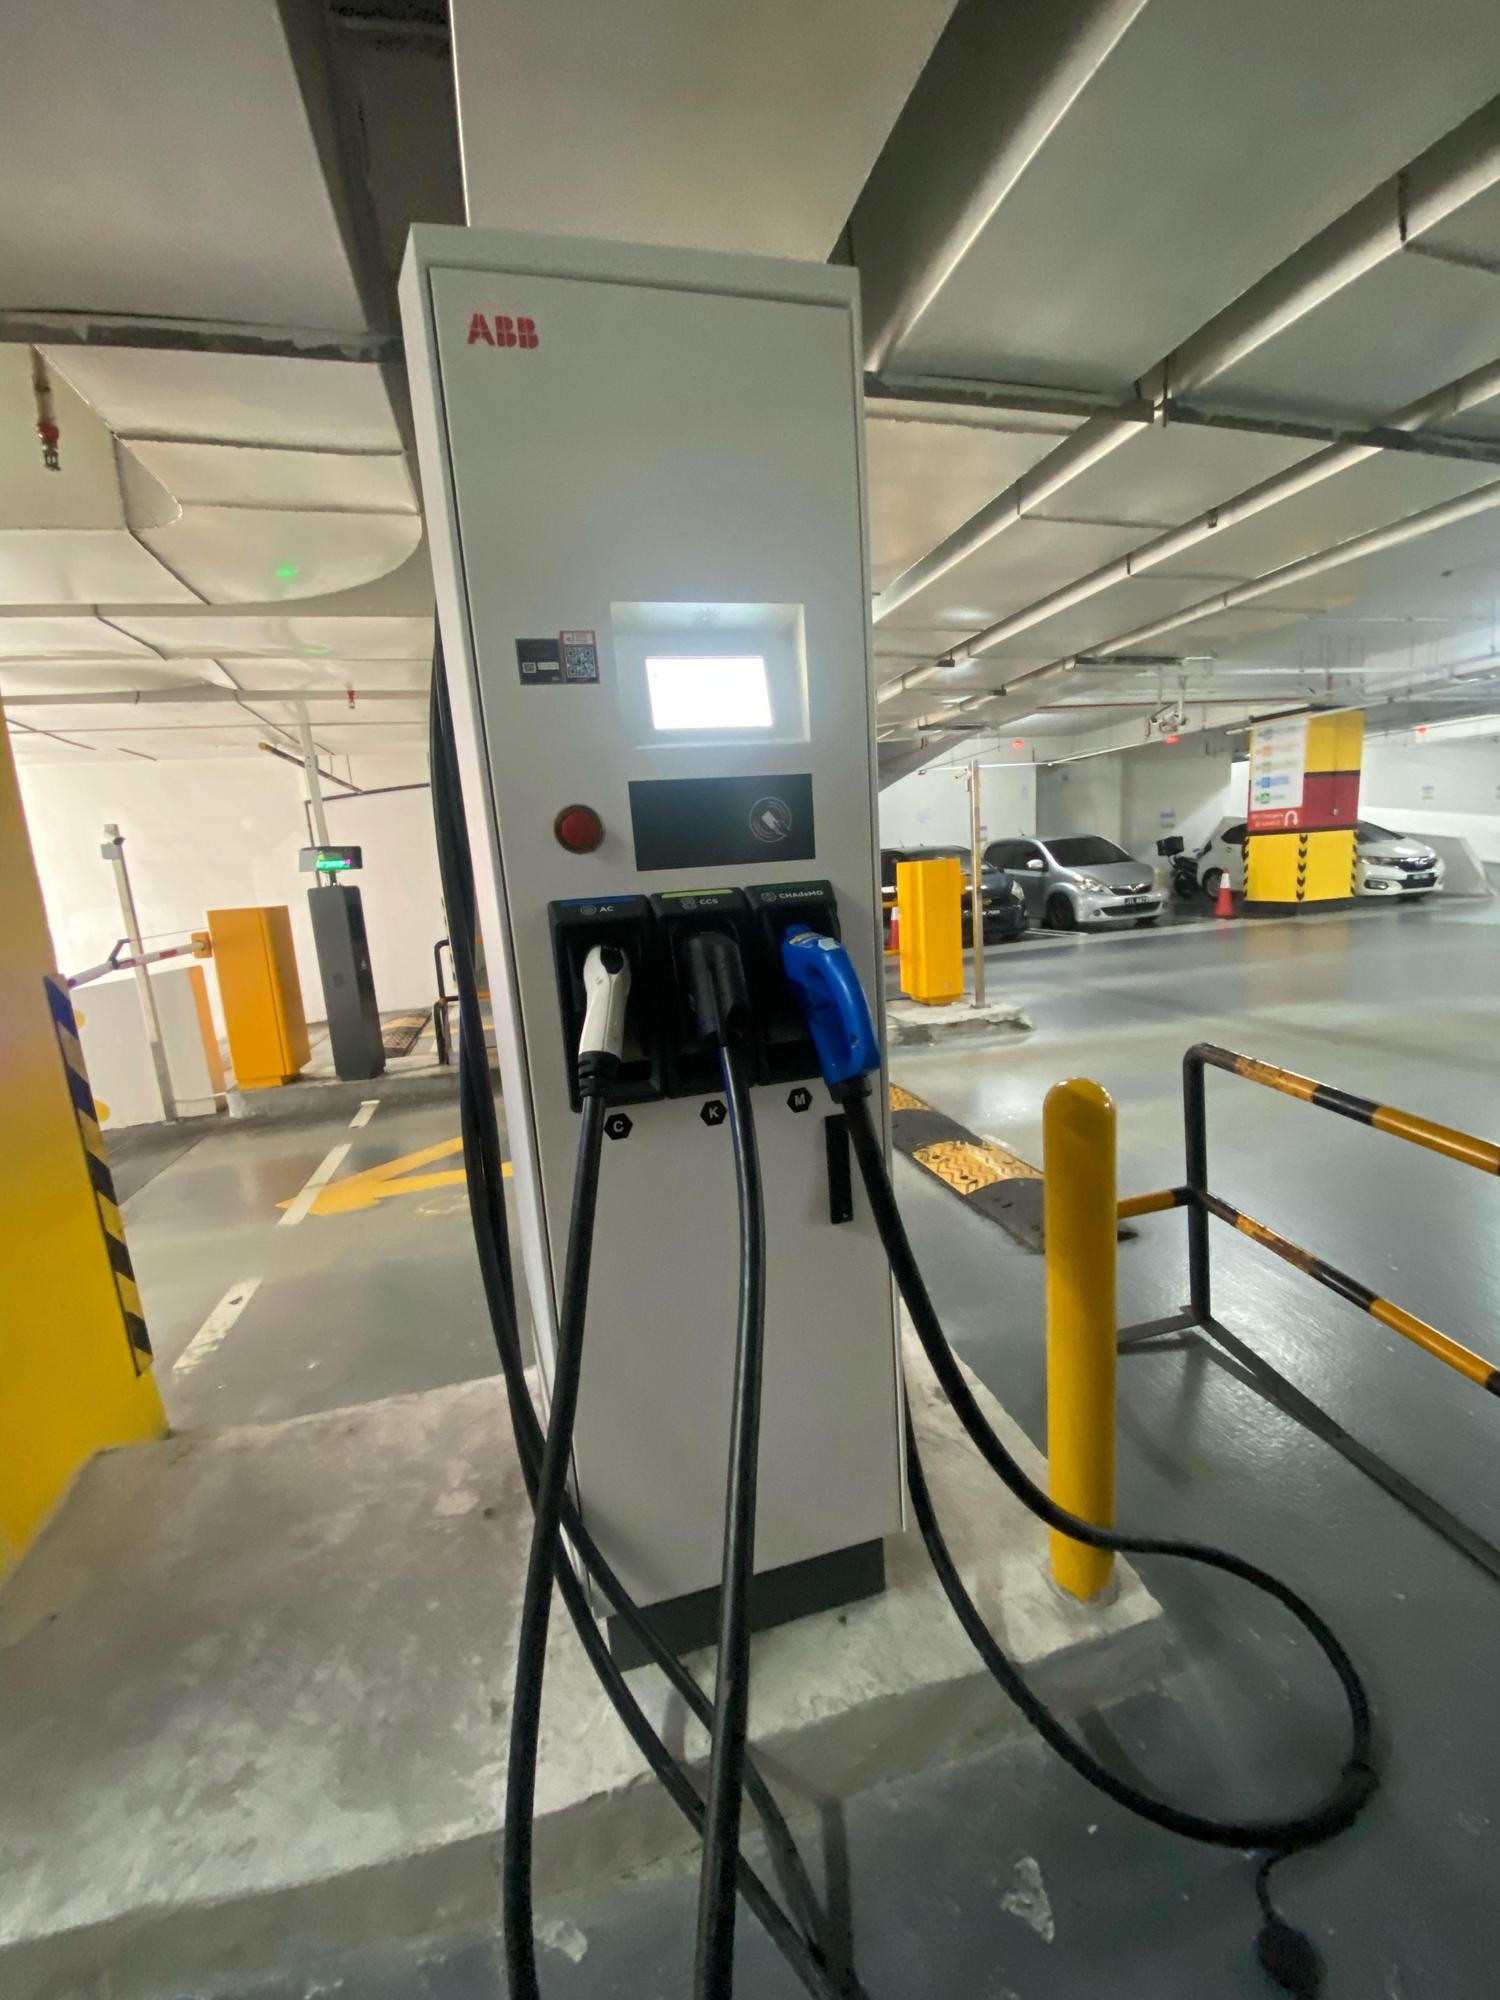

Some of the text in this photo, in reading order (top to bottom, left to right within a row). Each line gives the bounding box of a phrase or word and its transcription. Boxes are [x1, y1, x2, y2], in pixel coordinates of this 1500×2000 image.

[467, 313, 539, 349] ABB
[699, 898, 719, 906] CCS
[599, 905, 614, 913] AC
[794, 1094, 806, 1107] M
[708, 1106, 719, 1119] K
[613, 1120, 624, 1132] C
